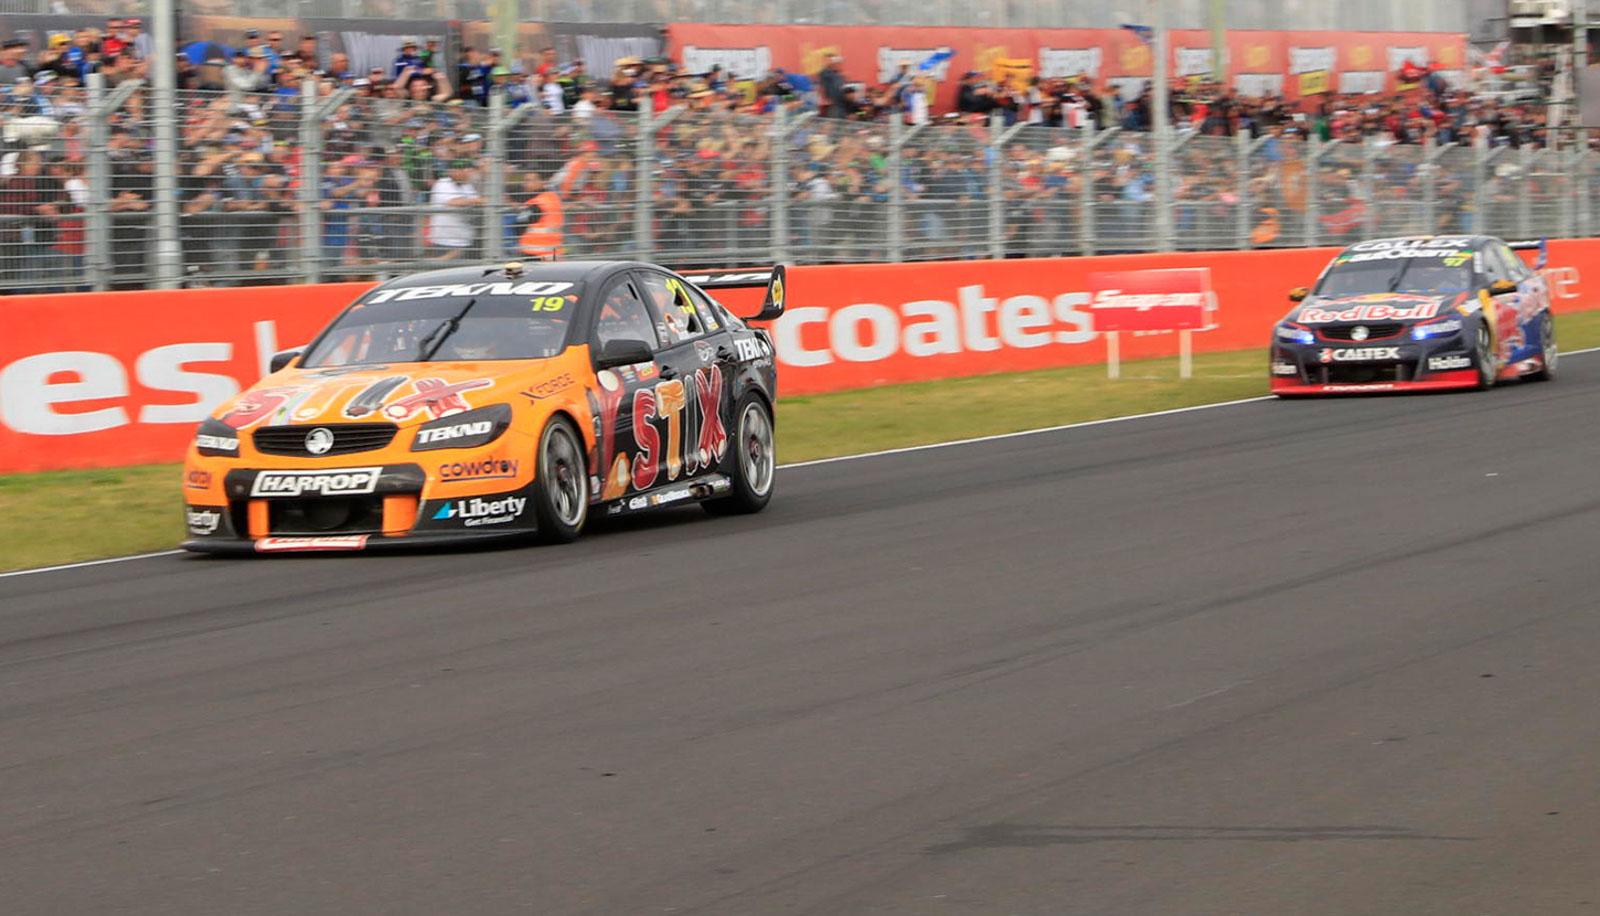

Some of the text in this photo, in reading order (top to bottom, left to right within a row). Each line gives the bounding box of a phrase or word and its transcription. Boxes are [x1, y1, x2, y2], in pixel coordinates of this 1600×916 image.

[366, 281, 574, 305] TEKNO
[530, 296, 565, 312] 19
[1297, 301, 1443, 323] Red Bull
[773, 284, 1100, 368] coates
[1333, 347, 1401, 361] CALTEX
[417, 420, 493, 444] TEKNO
[260, 472, 371, 493] HARROP
[457, 495, 527, 518] Liberty
